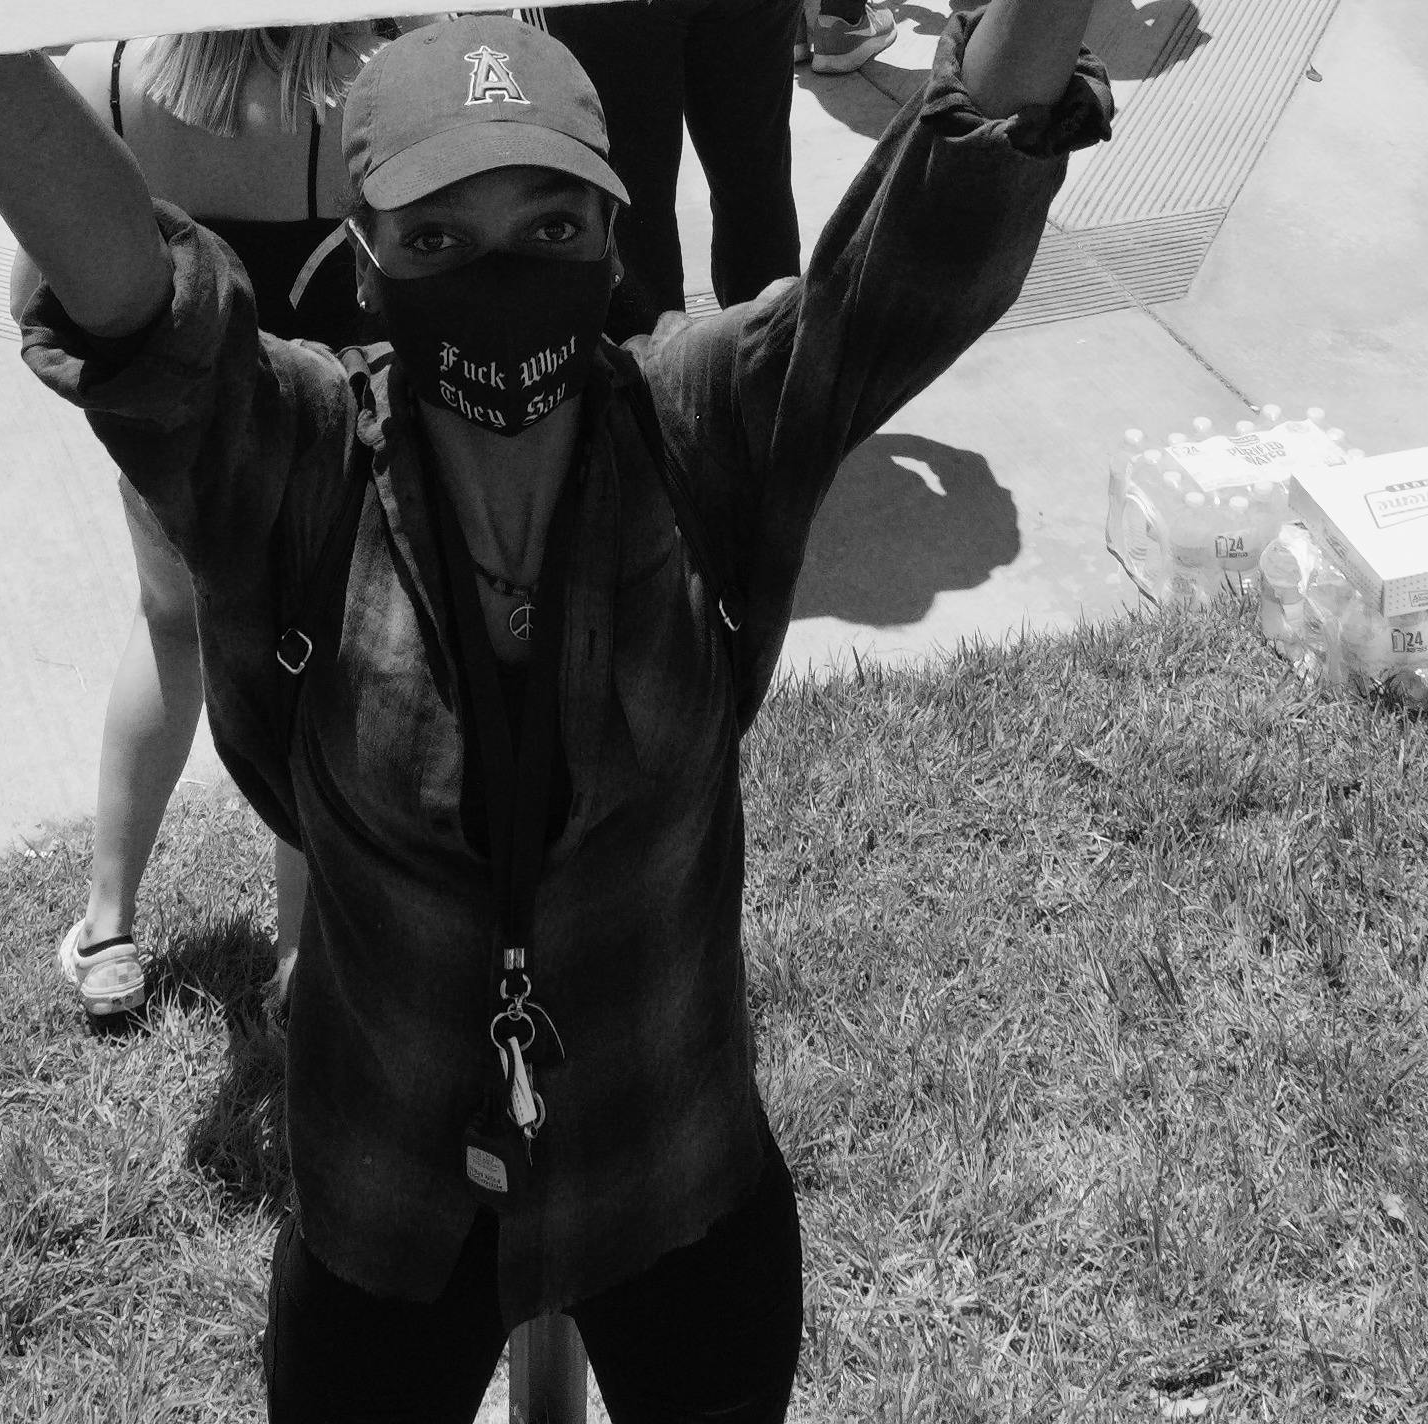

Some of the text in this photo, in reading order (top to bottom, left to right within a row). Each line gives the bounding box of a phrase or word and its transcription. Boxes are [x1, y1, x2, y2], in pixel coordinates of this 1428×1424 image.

[463, 45, 531, 106] A
[439, 335, 577, 391] Fuck What
[439, 379, 566, 428] They Say
[1228, 536, 1244, 552] 24
[1405, 630, 1423, 647] 24
